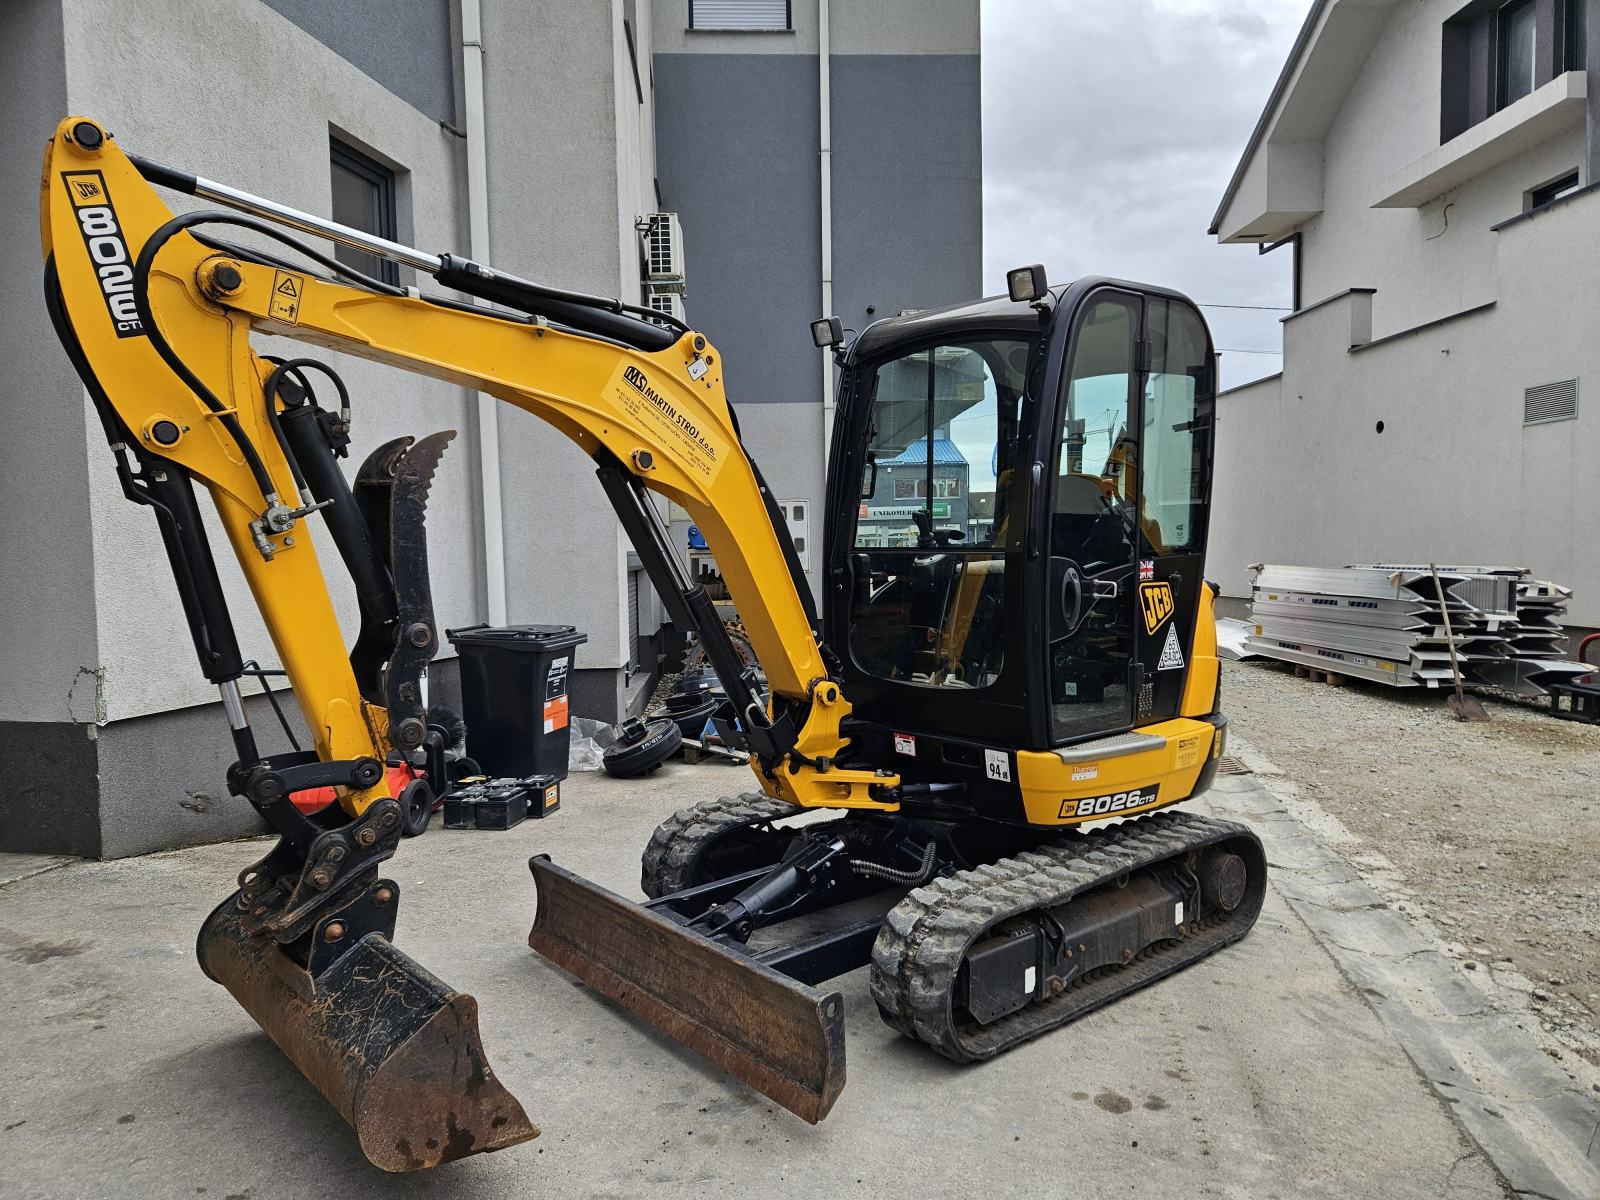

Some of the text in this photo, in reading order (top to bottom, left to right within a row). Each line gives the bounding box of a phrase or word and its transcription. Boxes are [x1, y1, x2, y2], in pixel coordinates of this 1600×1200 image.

[75, 182, 99, 198] JCB
[78, 207, 138, 321] 8026
[624, 366, 647, 392] MS
[645, 387, 677, 419] MARTIN
[676, 415, 700, 439] STROJ
[698, 435, 715, 456] d.o.o.
[1144, 586, 1172, 629] JCB
[989, 763, 1002, 779] 94
[1077, 790, 1141, 816] 8026
[1139, 794, 1156, 805] CTS
